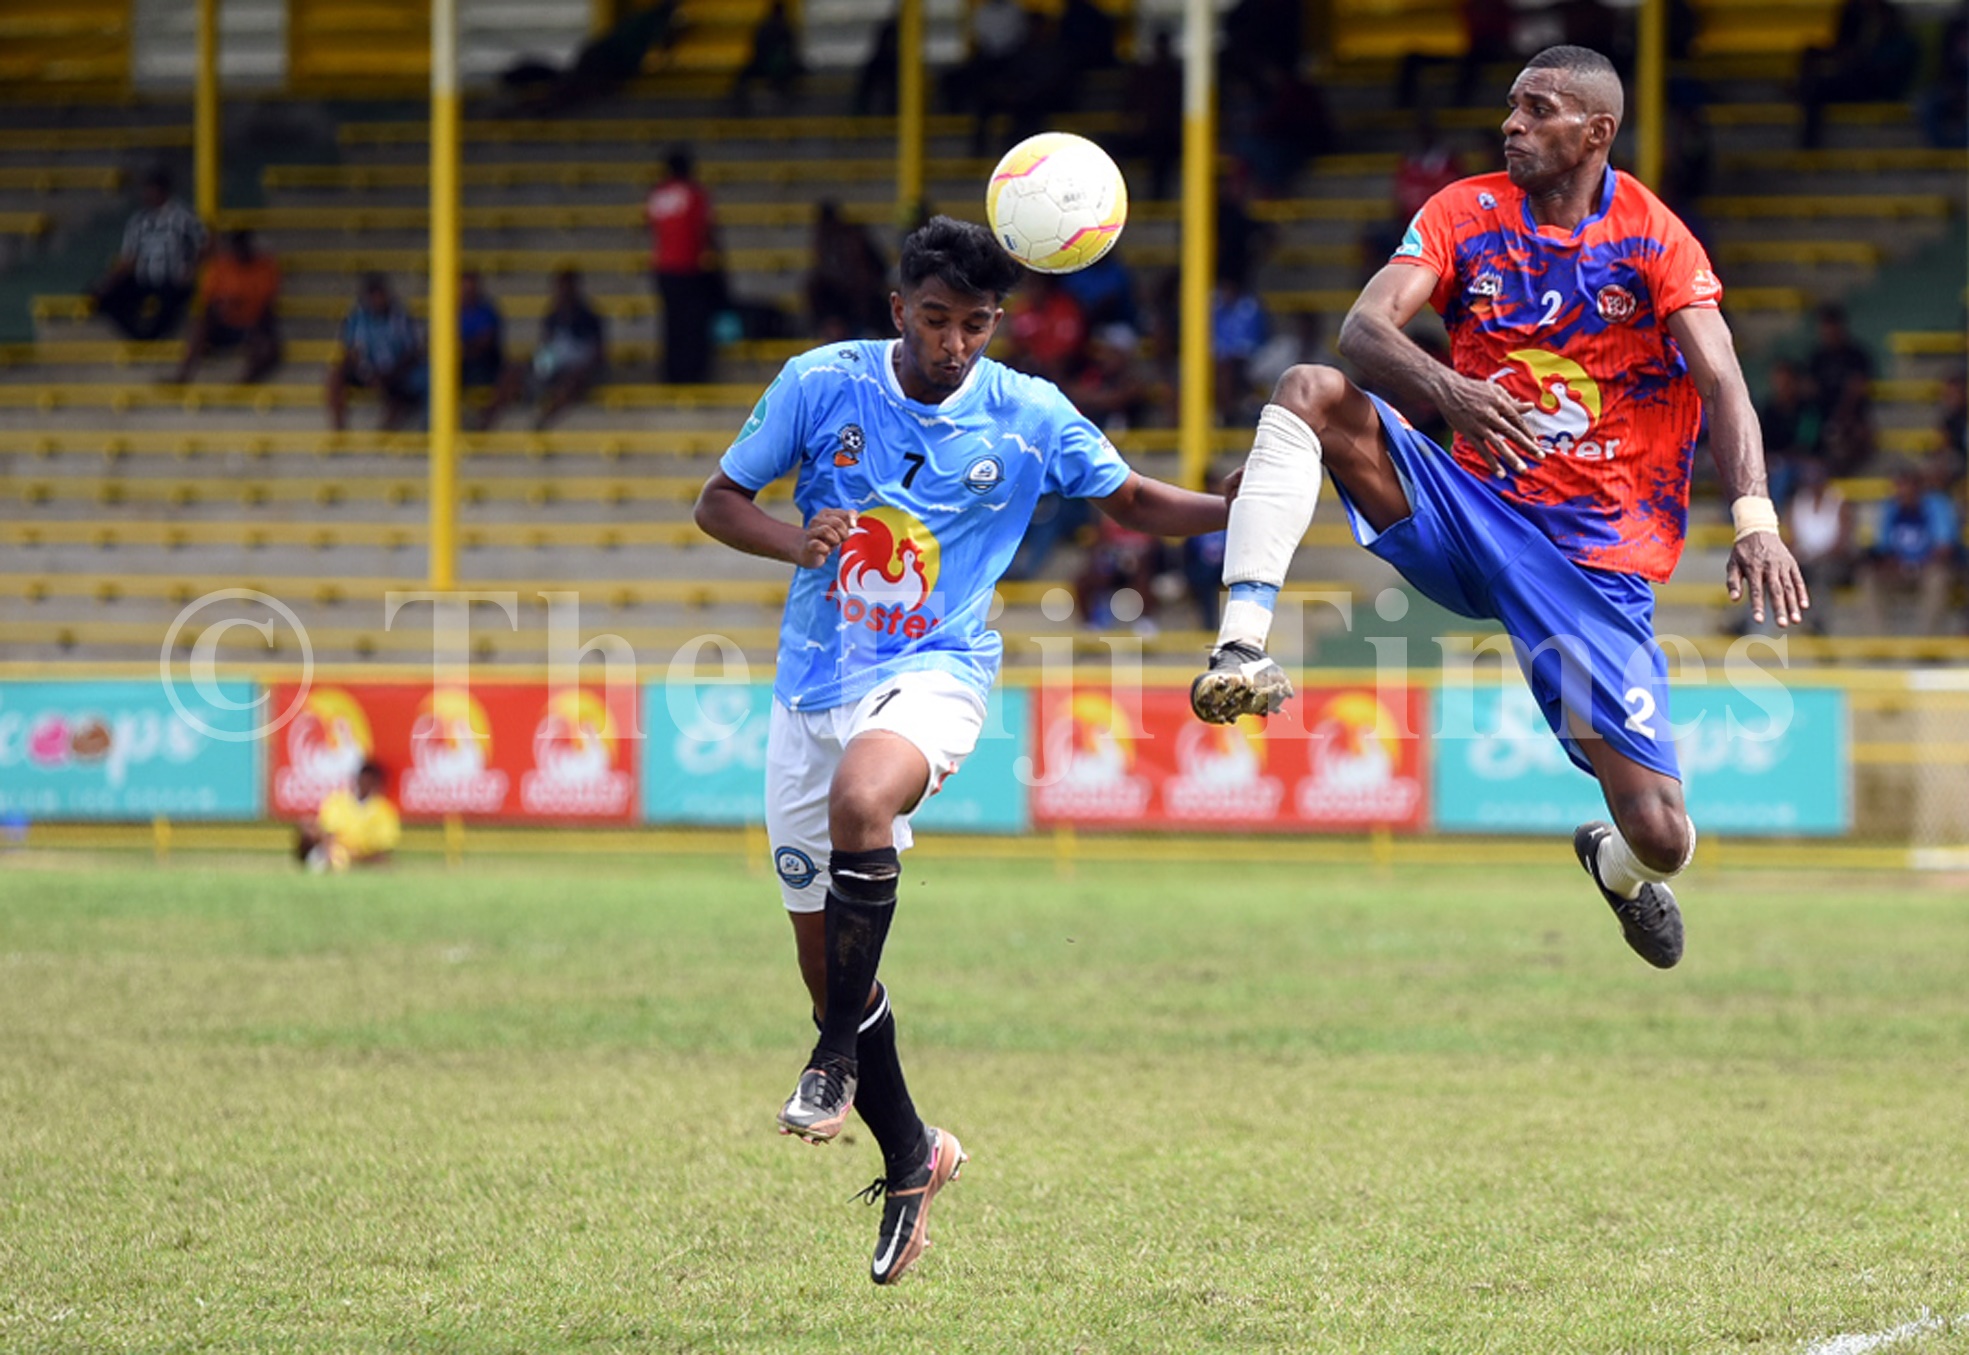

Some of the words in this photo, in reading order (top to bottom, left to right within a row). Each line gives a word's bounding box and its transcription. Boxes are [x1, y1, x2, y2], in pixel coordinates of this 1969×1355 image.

[1537, 290, 1564, 326] 2
[902, 452, 926, 490] 7
[1624, 687, 1656, 739] 2
